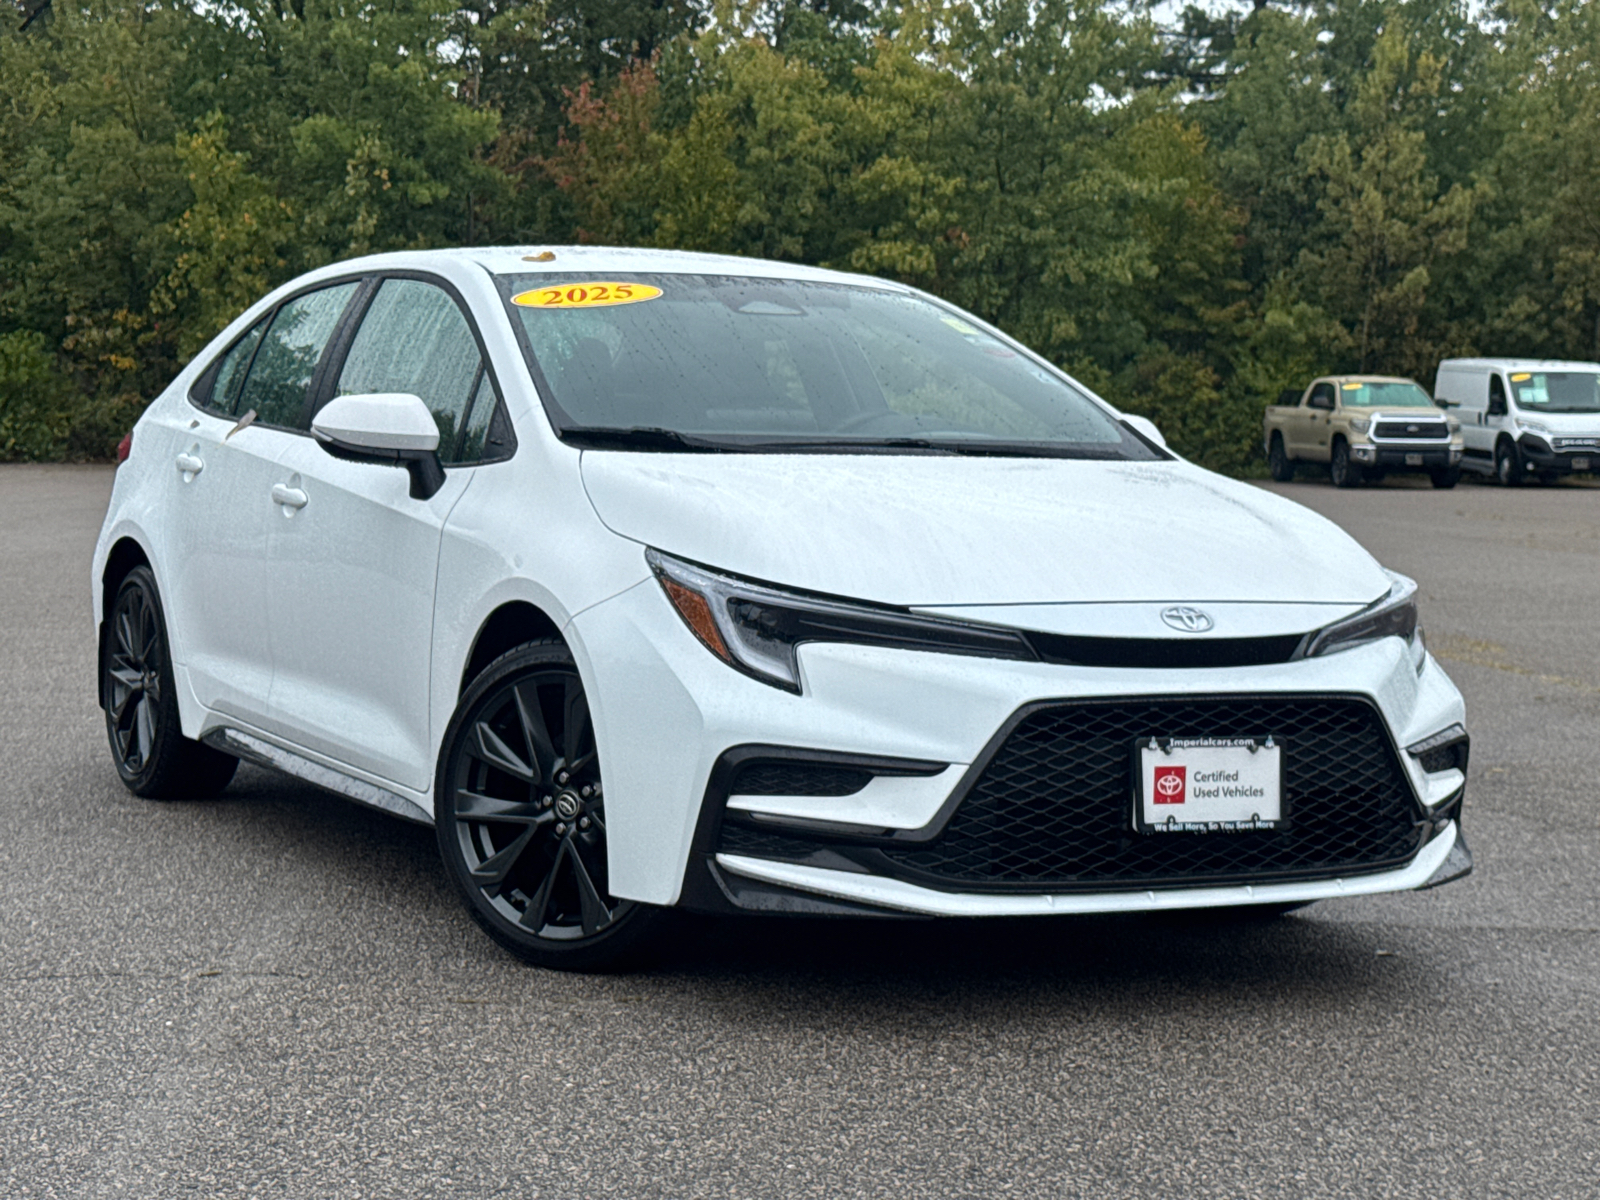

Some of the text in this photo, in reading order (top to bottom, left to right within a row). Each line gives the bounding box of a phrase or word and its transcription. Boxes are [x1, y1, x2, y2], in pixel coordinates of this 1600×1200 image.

[543, 285, 633, 305] 2025
[1170, 737, 1254, 747] Imperialcars.com
[1194, 770, 1238, 782] Certified
[1194, 785, 1264, 798] Used Vehicles
[1154, 823, 1167, 831] We
[1208, 821, 1218, 830] So
[1220, 821, 1235, 830] You
[1236, 821, 1254, 829] Save
[1256, 820, 1274, 829] More
